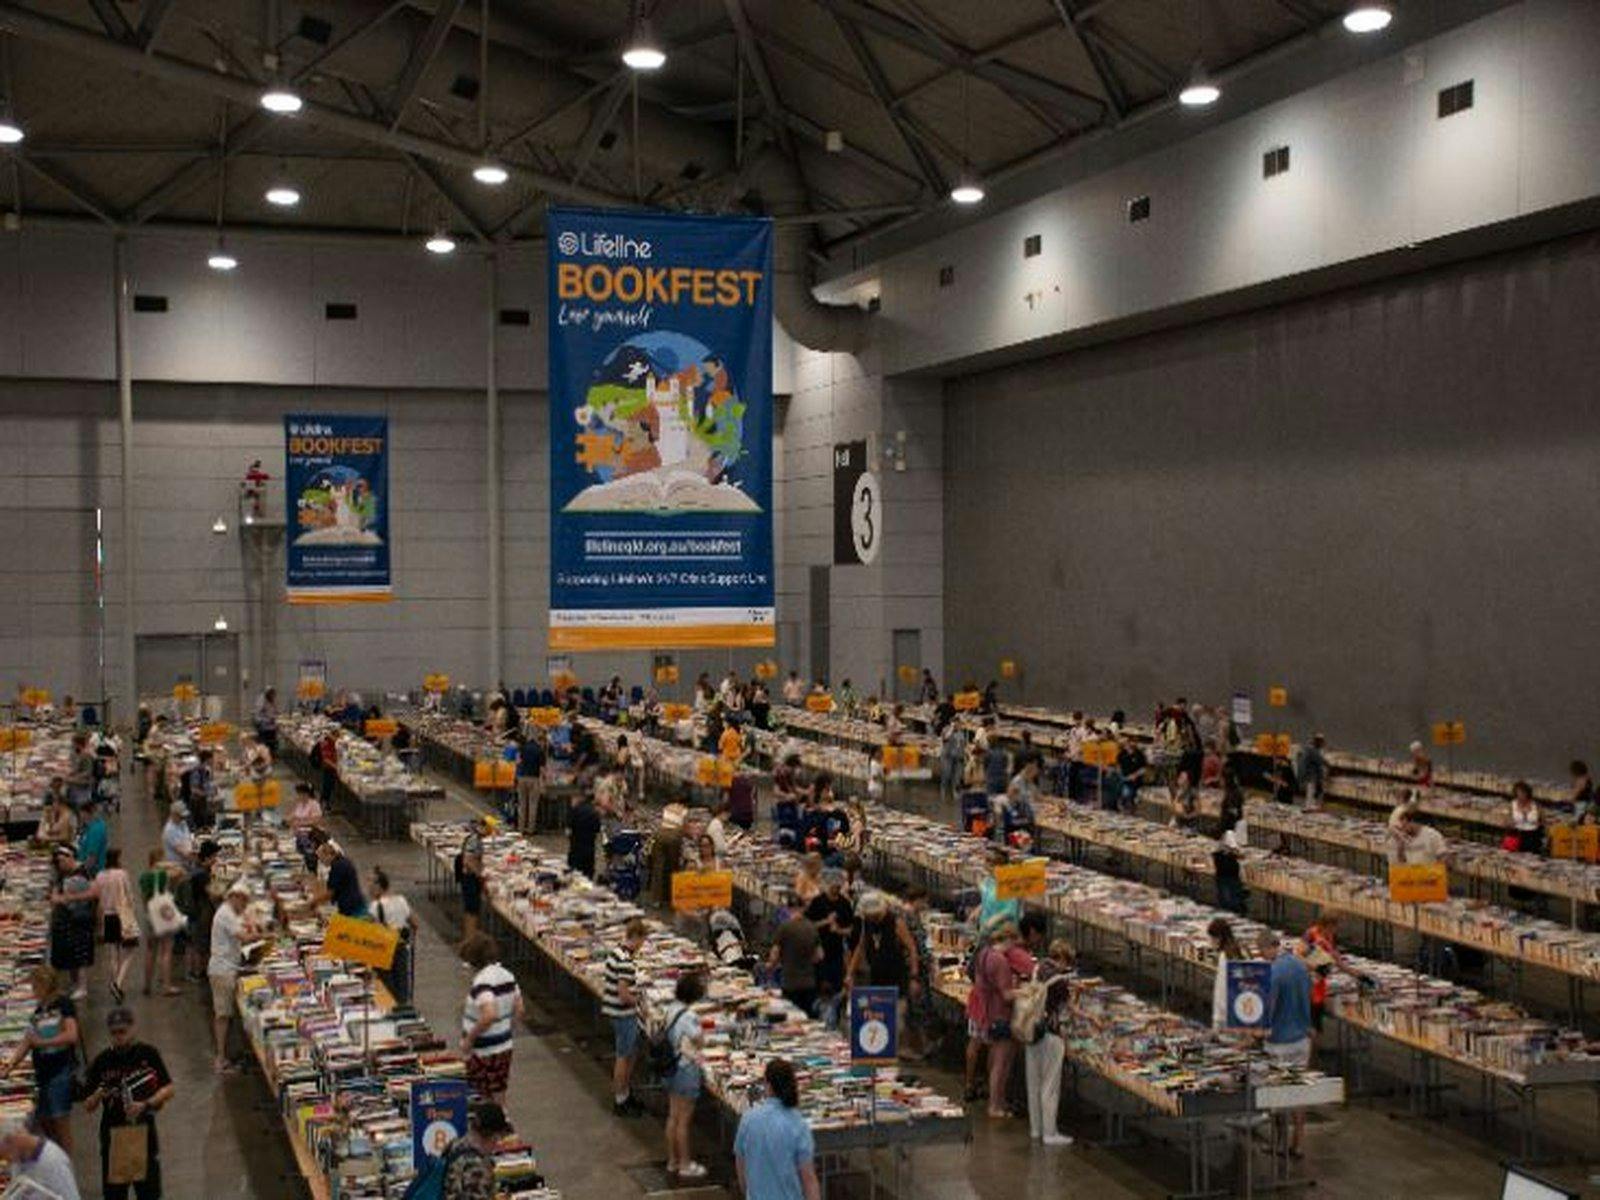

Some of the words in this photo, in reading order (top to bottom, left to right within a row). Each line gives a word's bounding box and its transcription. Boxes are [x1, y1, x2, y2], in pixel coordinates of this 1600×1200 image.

[581, 232, 651, 258] Lifeline
[558, 263, 762, 307] BOOKFEST
[289, 437, 383, 455] BOOKFEST
[861, 486, 874, 550] 3
[434, 1129, 447, 1150] 8
